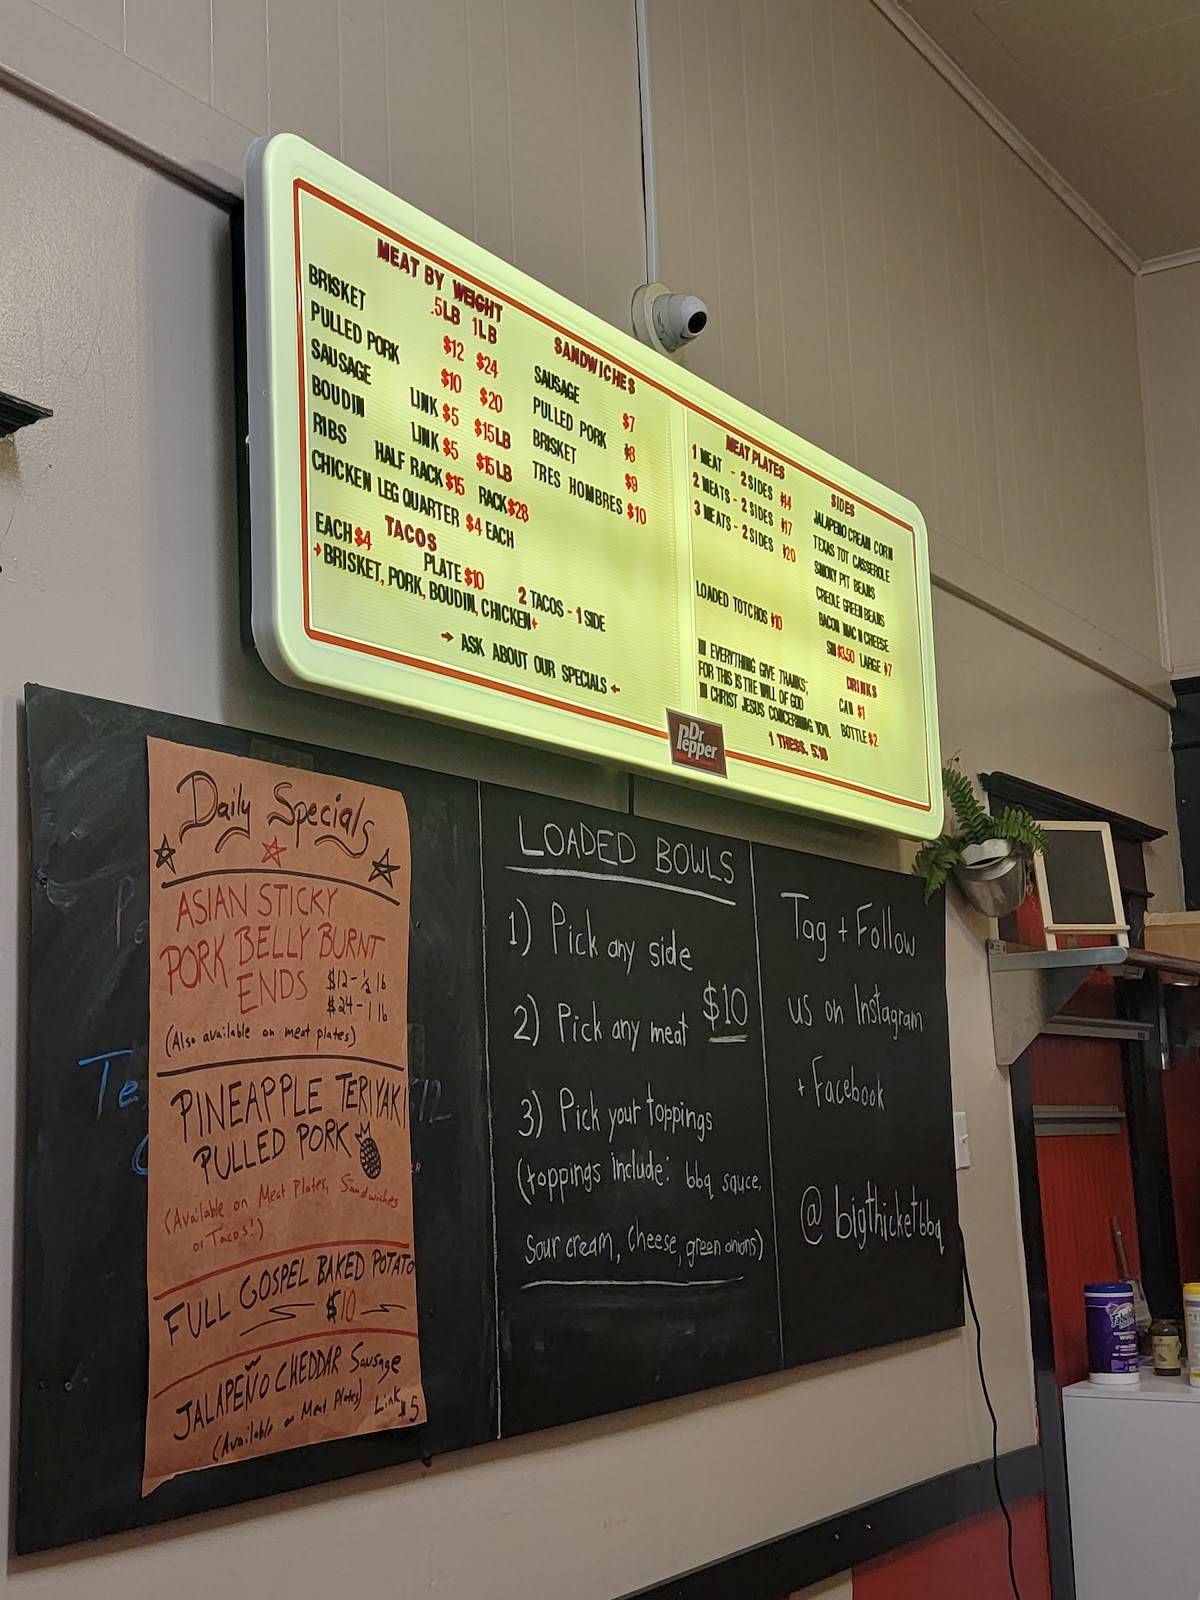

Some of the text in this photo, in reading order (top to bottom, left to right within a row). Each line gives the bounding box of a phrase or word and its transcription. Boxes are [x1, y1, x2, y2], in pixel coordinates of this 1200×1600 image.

[377, 237, 503, 323] MEAT BY WEIGHT
[308, 263, 499, 379] BRISKET $12 $24
[431, 296, 497, 344] .5LB 1LB
[311, 300, 503, 413] PULLED PORK $10 $20
[311, 338, 459, 427] SAUSAGE LINK $5
[554, 336, 636, 395] SANDWICHES
[312, 374, 459, 460] BOUDIN LINK $5
[533, 396, 607, 449] PULLED PORK
[534, 365, 635, 432] SAUSAGE $7
[313, 412, 529, 523] RIBS HALF RACK $15 RACK $28
[533, 428, 638, 493] BRISKET $9
[700, 447, 773, 501] MEAT SIDES
[726, 435, 785, 480] MEAT PLATES
[311, 449, 514, 549] CHICKEN LEG QUARTER $4 EACH
[532, 460, 647, 525] TRES HOMBRES $10
[702, 475, 774, 526] MEATS SIDES
[831, 493, 855, 517] SIDES
[385, 514, 437, 552] TACOS
[703, 504, 774, 553] MEATS SIDES
[813, 510, 893, 561] JALAPENO CREAM CORN
[315, 511, 606, 632] EACH $4 PLATE $10 2 TACOS SIDE
[813, 534, 891, 584] TEXAS TOT CASSEROLE
[814, 560, 876, 600] SMOKY PIT BEANS
[323, 542, 532, 631] BRISKET, PORK, BOUDIN, CHICKEN
[696, 580, 768, 625] LOADED TOTCHOS
[816, 586, 886, 628] CREOLE GREEN BEANS
[818, 611, 890, 653] BACON MAC CHEESE
[461, 633, 608, 695] ASK ABOUT OUR SPECIALS
[698, 659, 804, 711] FOR THIS THE WILL OF GOD
[710, 642, 775, 681] EVERYTHING GIVE
[846, 676, 878, 699] DRINKS
[859, 653, 881, 674] LARGE
[689, 721, 705, 742] Dr
[710, 686, 814, 733] CHRIST JESUS CONCERNING
[839, 698, 854, 715] CAN
[677, 723, 718, 760] Pepper
[840, 723, 868, 744] BOTTLE
[176, 770, 375, 859] Daily Specials
[518, 815, 735, 885] LOADED BOWLS
[176, 883, 248, 932] ASIAN
[257, 882, 339, 917] STICKY
[780, 892, 916, 962] Tag Follow
[159, 921, 386, 997] PORK BELLY BURNT
[508, 898, 693, 976] 1) Pick any side
[237, 968, 308, 1015] ENDS
[651, 980, 748, 1047] meat $10
[788, 983, 923, 1040] us on Instagram
[165, 1023, 356, 1058] (Also available on meat plates)
[170, 1073, 323, 1143] PINEAPPLE
[335, 1071, 407, 1129] TERIYAKI
[811, 1055, 885, 1112] Facebook
[608, 1081, 713, 1143] your toppings
[193, 1127, 286, 1186] PULLED
[296, 1118, 352, 1162] PORK
[340, 1173, 399, 1209] Sandwiches
[517, 1157, 601, 1205] (toppings
[685, 1160, 715, 1200] bbq
[835, 1180, 945, 1255] bigthicketbbq
[686, 1239, 721, 1269] green
[725, 1228, 764, 1261] onions)
[163, 1248, 415, 1346] FULL GOSPEL BAKED POTATO
[326, 1289, 356, 1324] $10
[275, 1345, 342, 1393] CHEDDAR
[350, 1341, 401, 1385] Sausage
[374, 1388, 401, 1415] Link
